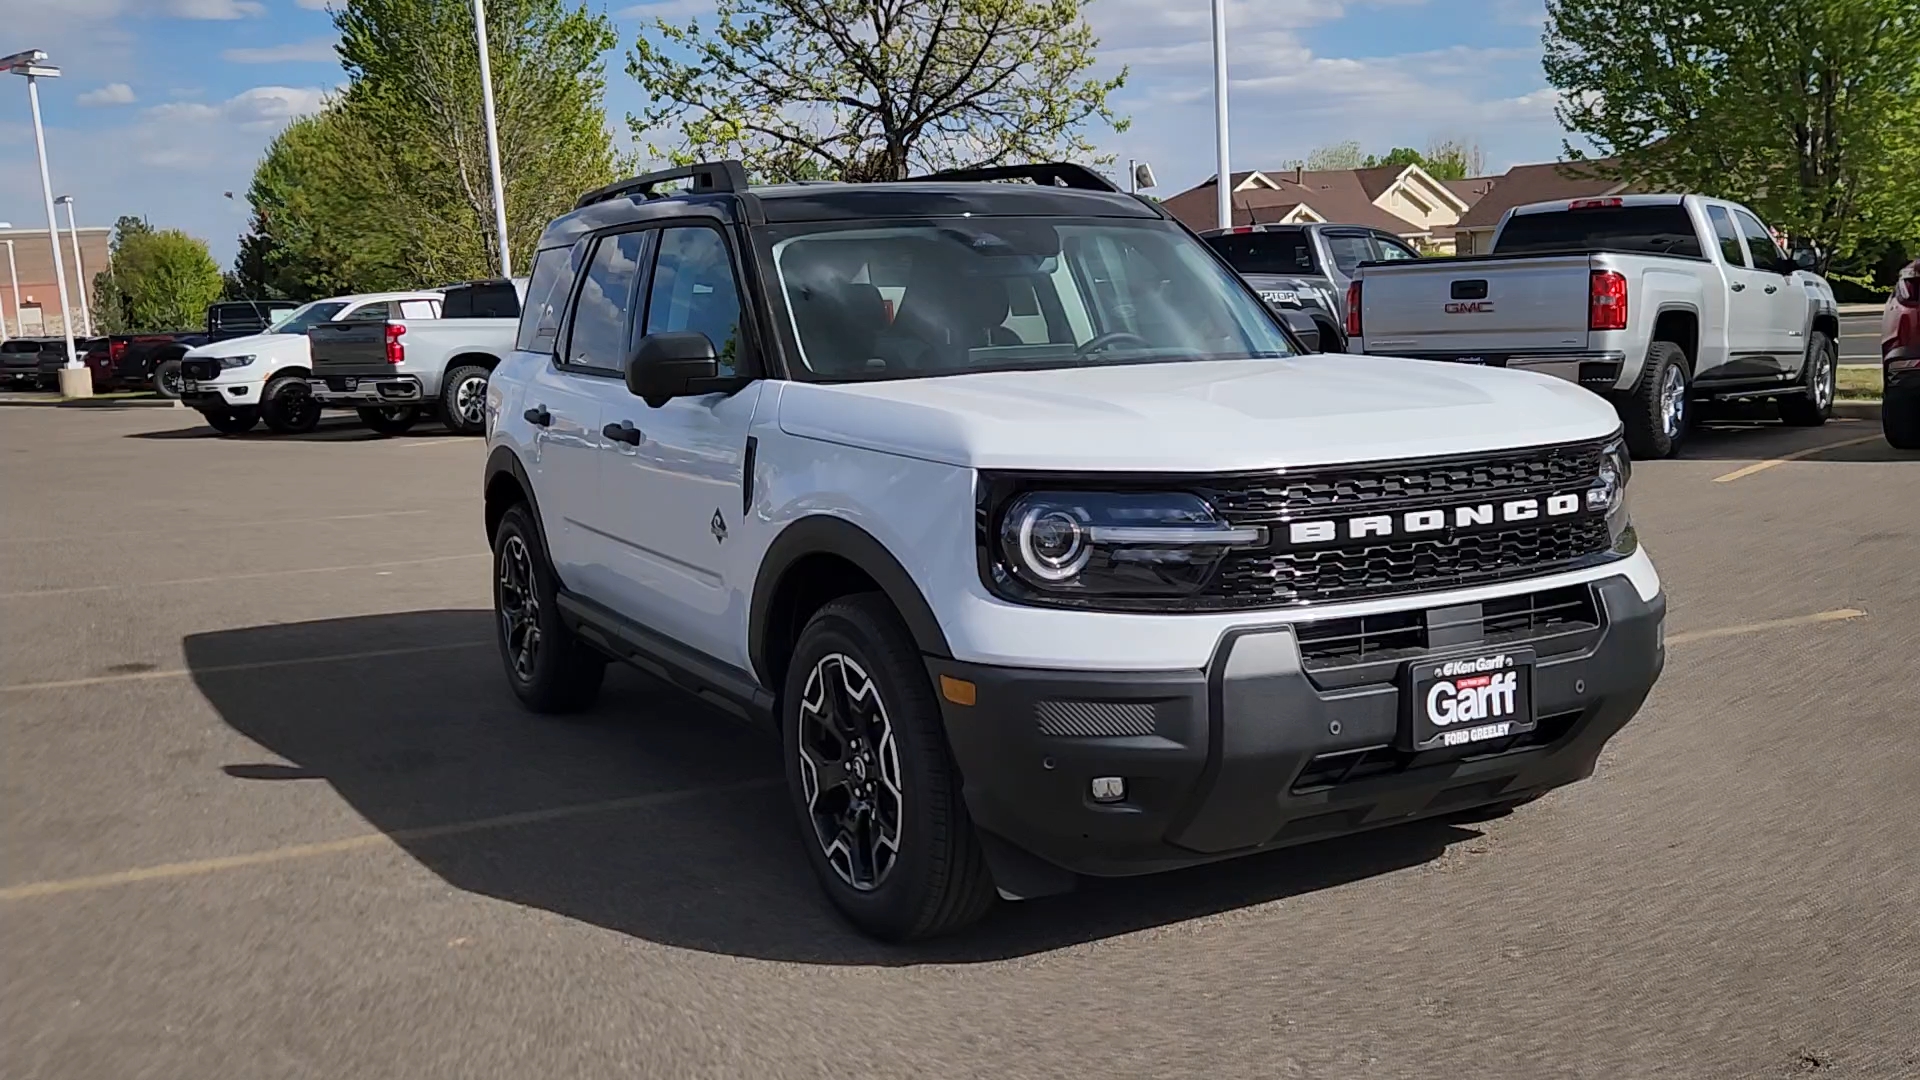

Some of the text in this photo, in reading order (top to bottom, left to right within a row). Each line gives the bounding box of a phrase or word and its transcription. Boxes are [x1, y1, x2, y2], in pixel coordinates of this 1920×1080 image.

[1444, 301, 1495, 314] GMC
[1289, 493, 1580, 544] BRONCO
[1454, 660, 1476, 676] Ken
[1476, 654, 1505, 672] Garff
[1427, 671, 1517, 727] Garff
[1444, 723, 1511, 747] FORD GREELEY
